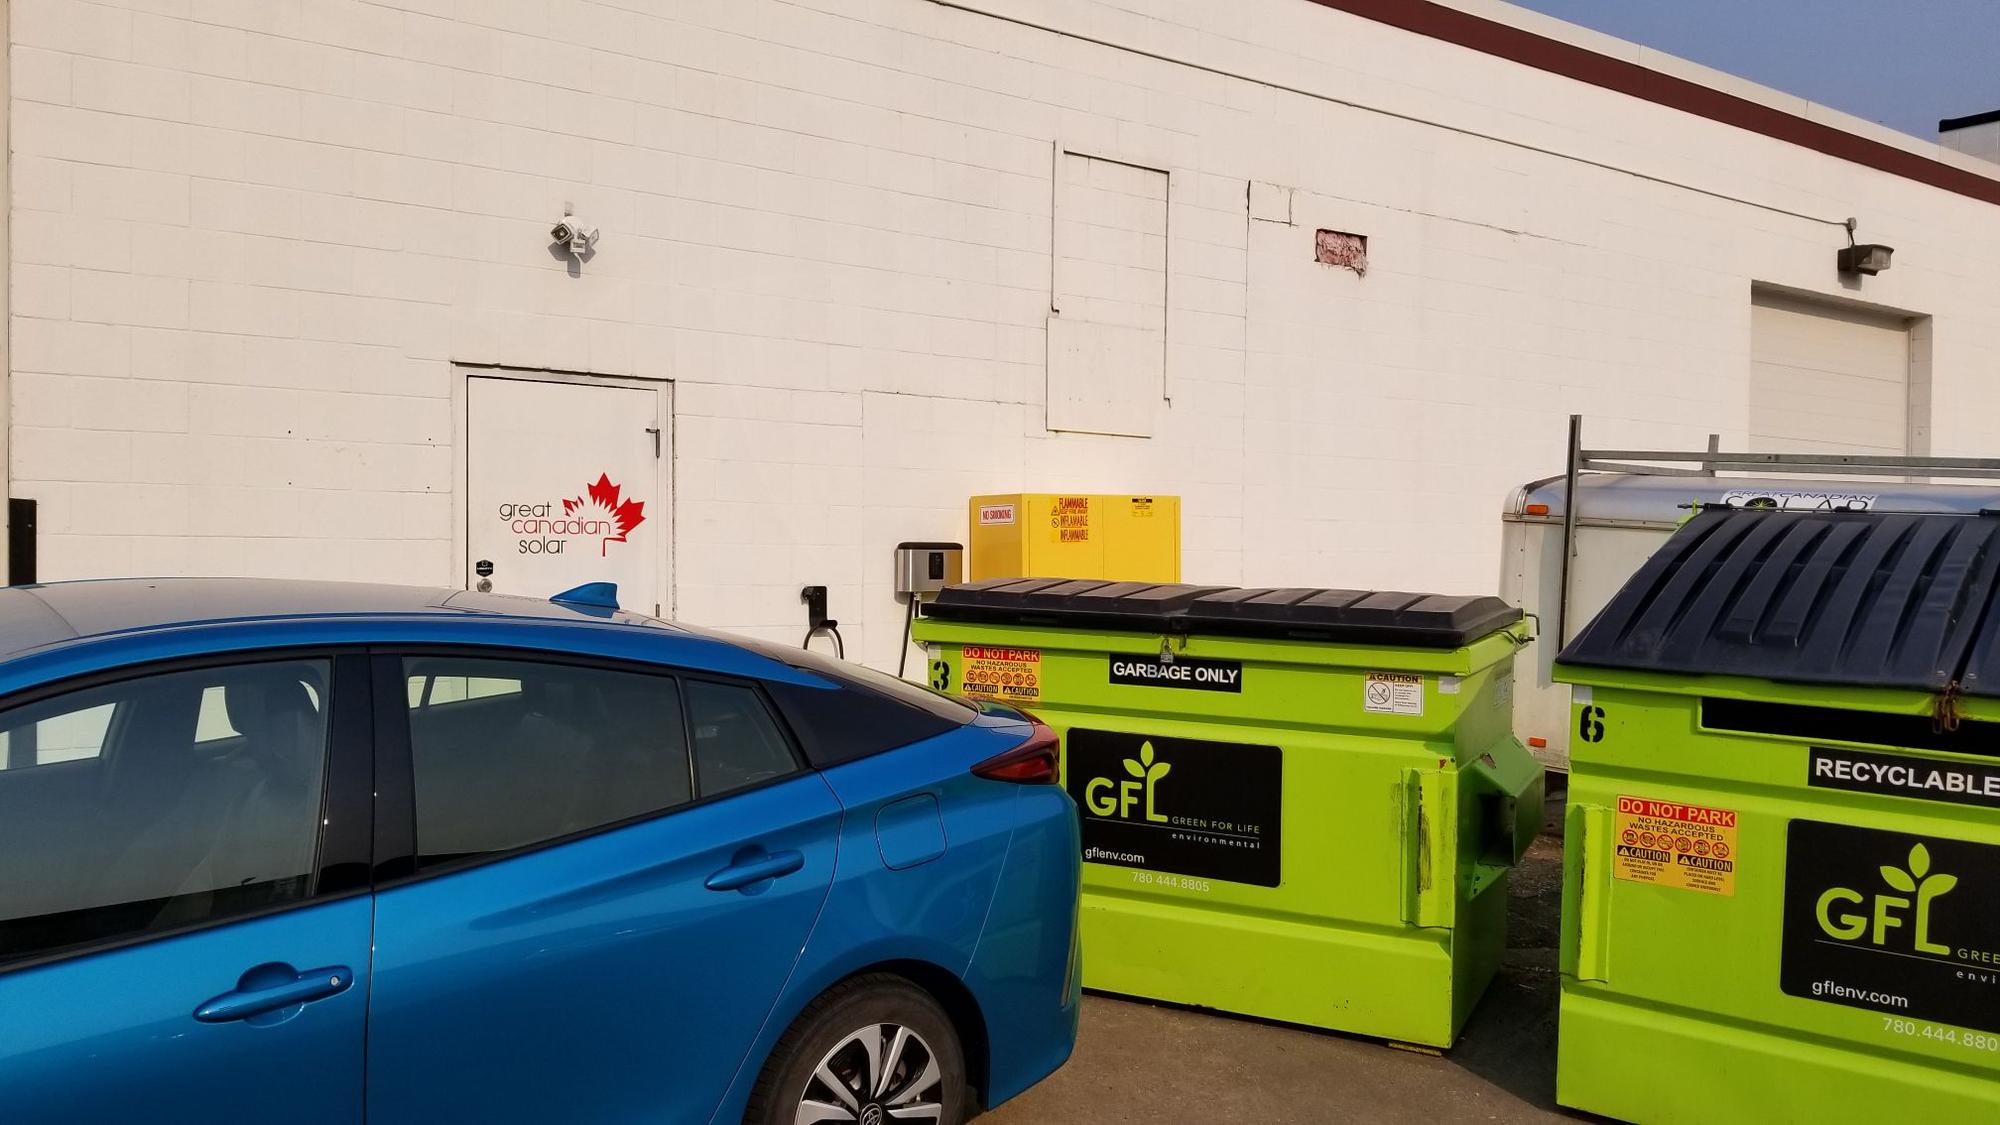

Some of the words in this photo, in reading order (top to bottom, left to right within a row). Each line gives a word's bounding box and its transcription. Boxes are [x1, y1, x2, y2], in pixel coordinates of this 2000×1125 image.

[1059, 497, 1088, 508] FLAMMABLE
[1779, 492, 1875, 501] CANADIAN
[499, 501, 552, 521] great
[983, 510, 989, 520] NO
[990, 509, 1011, 519] SMOKING
[511, 517, 611, 535] canadian
[518, 536, 567, 554] solar
[964, 647, 980, 658] DO
[983, 648, 1006, 659] NOT
[1008, 650, 1039, 661] PARK
[933, 661, 950, 690] 3
[999, 666, 1033, 674] ACCEPTED
[1112, 661, 1191, 681] GARBAGE
[1194, 667, 1238, 684] ONLY
[1377, 673, 1418, 683] CAUTION
[971, 684, 998, 693] CAUTION
[1011, 686, 1038, 695] CAUTION
[1579, 705, 1605, 743] 6
[1815, 757, 2000, 797] RECYCLABLE
[1085, 761, 1171, 823] GFL
[1620, 799, 1644, 813] DO
[1649, 802, 1683, 819] NOT
[1688, 807, 1734, 827] PARK
[1172, 816, 1207, 828] GREEN
[1211, 820, 1233, 830] FOR
[1237, 823, 1260, 834] LIFE
[1629, 822, 1668, 833] WASTES
[1671, 828, 1724, 841] ACCEPTED
[1654, 819, 1715, 833] HAZARDOUS
[1172, 832, 1260, 849] environmental
[1085, 846, 1145, 864] gflenv.com
[1630, 847, 1669, 862] CAUTION
[1690, 856, 1732, 872] CAUTION
[1815, 872, 1950, 956] GFL
[1957, 948, 2000, 965] GREE
[1956, 970, 1996, 984] envi
[1812, 979, 1908, 1008] gflenv.com
[1882, 1017, 1999, 1052] 780.444.880
